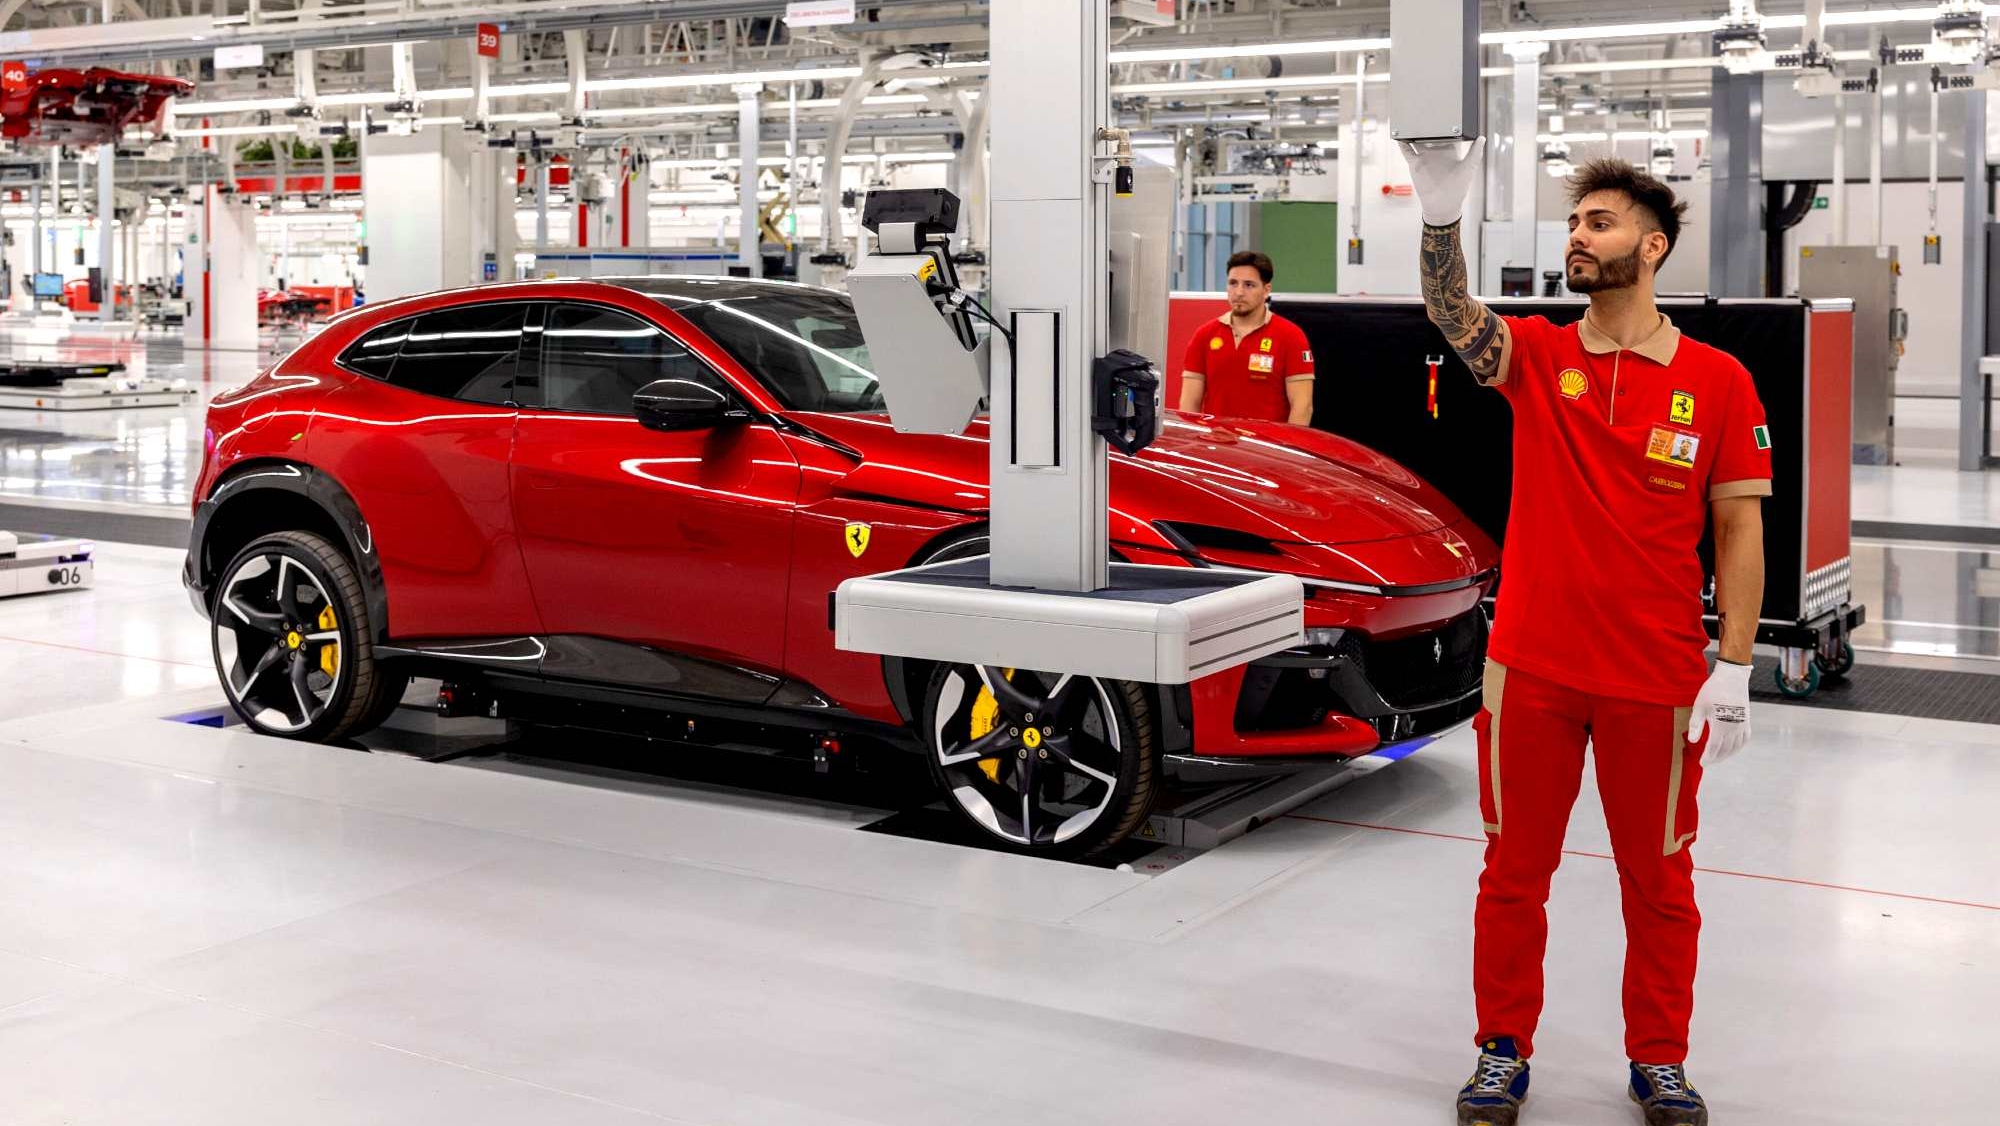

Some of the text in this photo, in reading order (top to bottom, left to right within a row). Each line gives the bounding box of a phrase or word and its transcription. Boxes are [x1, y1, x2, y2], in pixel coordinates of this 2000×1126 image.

[480, 33, 497, 48] 39
[4, 70, 25, 82] 40
[60, 566, 81, 585] 06
